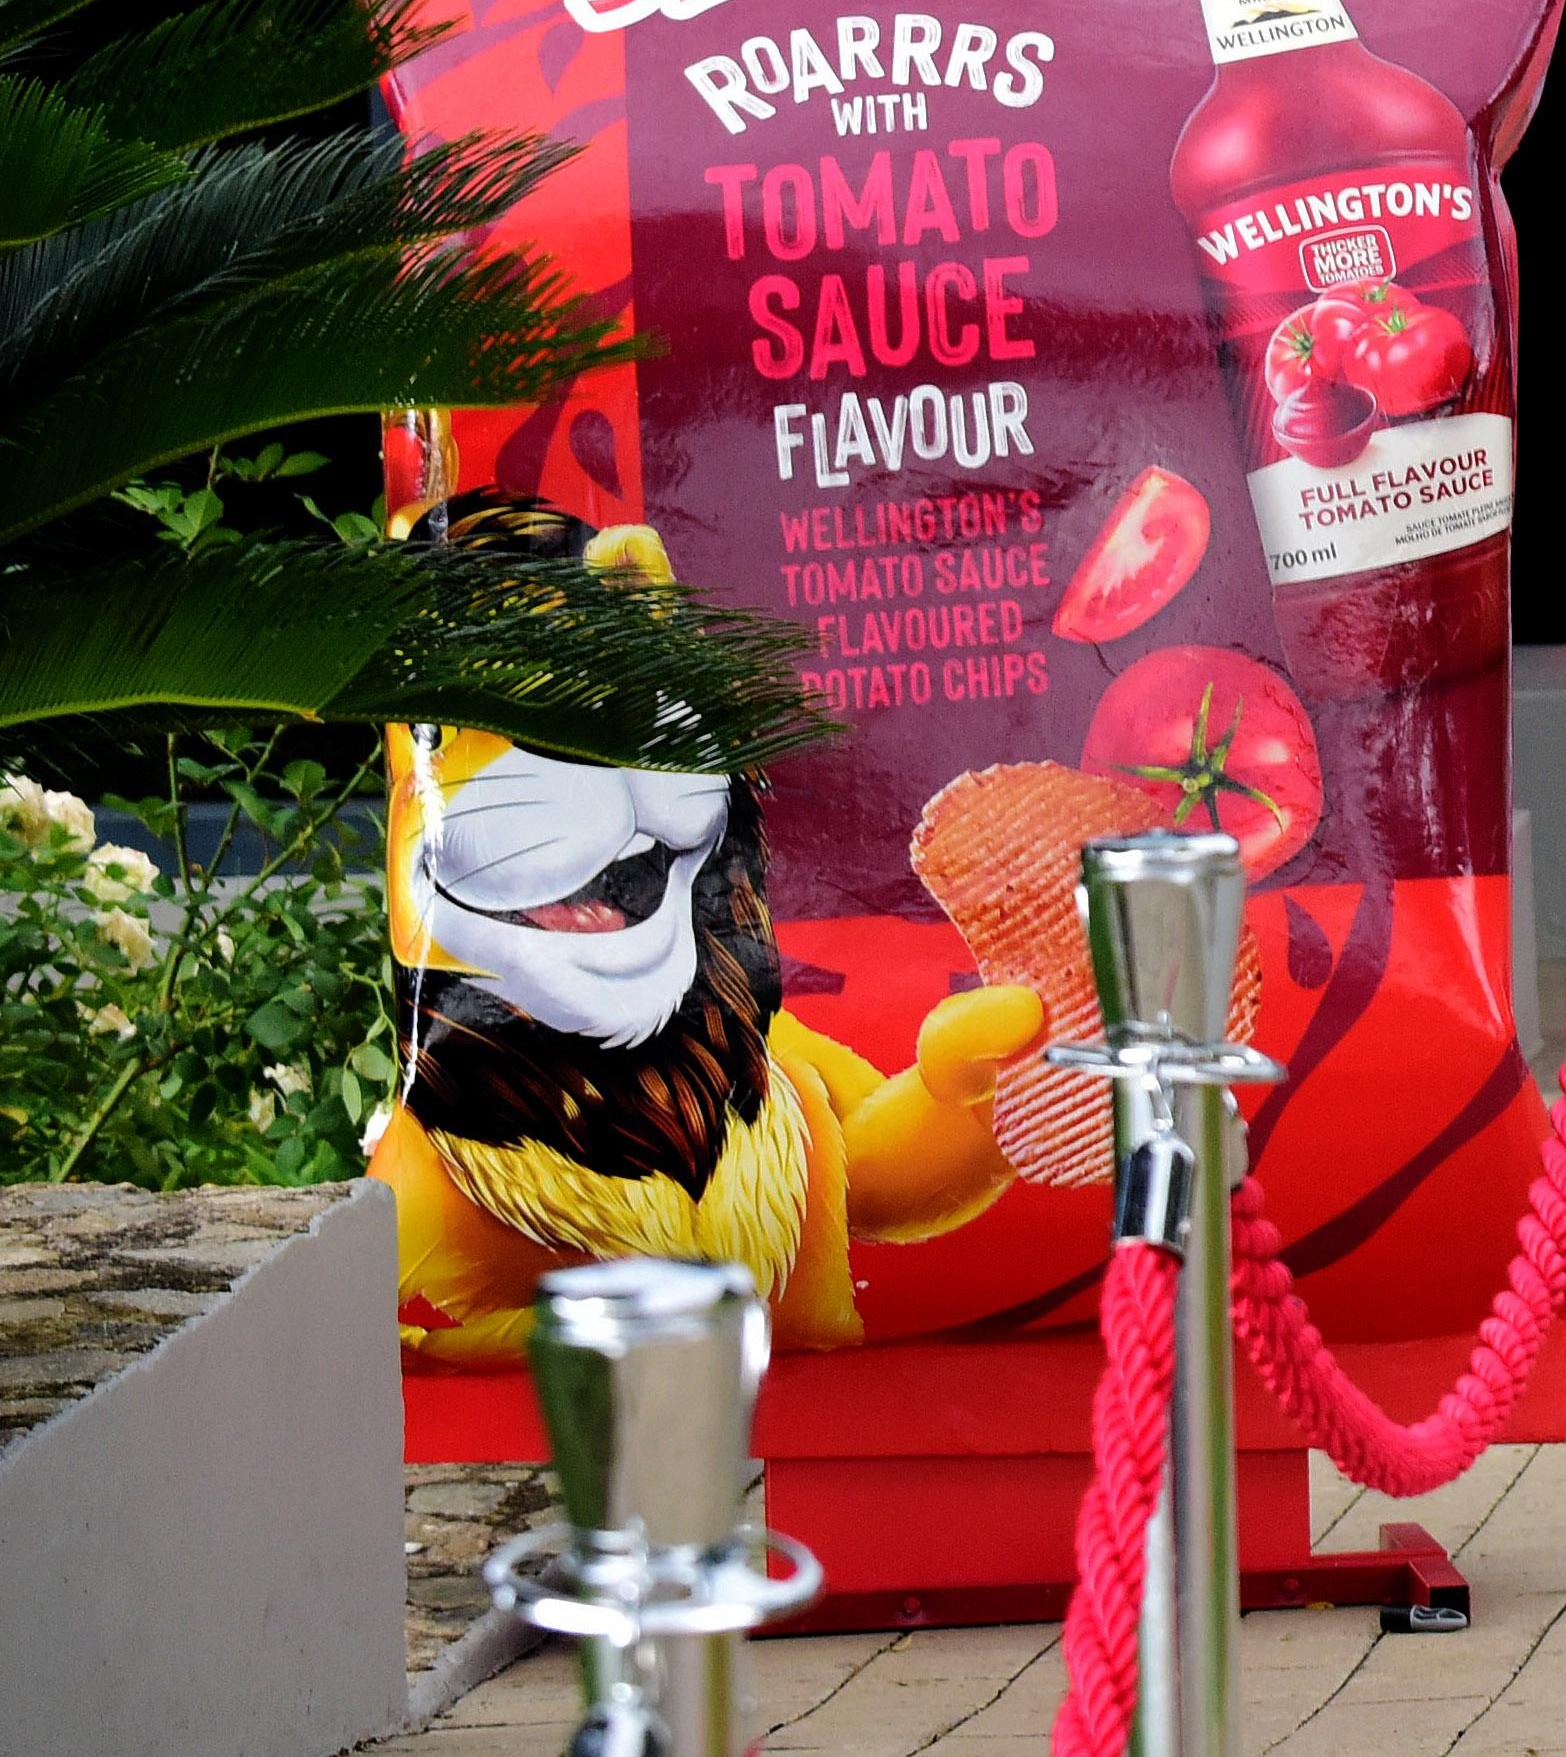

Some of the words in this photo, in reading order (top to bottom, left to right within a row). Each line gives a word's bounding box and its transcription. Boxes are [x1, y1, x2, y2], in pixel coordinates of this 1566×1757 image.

[1216, 14, 1346, 50] WELLINGTON
[684, 13, 1055, 135] ROARRRS
[831, 92, 928, 136] WITH
[704, 137, 1059, 261] TOMATO
[1197, 182, 1472, 265] WELLINGTON'S
[1311, 234, 1376, 257] THICKER
[1313, 247, 1383, 273] MORE
[748, 256, 1036, 380] SAUCE
[773, 381, 1035, 488] FLAVOUR
[1299, 492, 1412, 530] TOMATO
[1418, 469, 1494, 504] SAUCE
[1300, 480, 1366, 508] FULL
[1371, 449, 1488, 490] FLAVOUR
[779, 489, 1044, 554] WELLINGTON'S
[780, 553, 924, 608] TOMATO
[934, 543, 1051, 594] SAUCE
[1269, 551, 1308, 571] 700
[1312, 542, 1337, 563] ml
[817, 599, 1023, 660] FLAVOURED
[943, 651, 1049, 702] CHIPS
